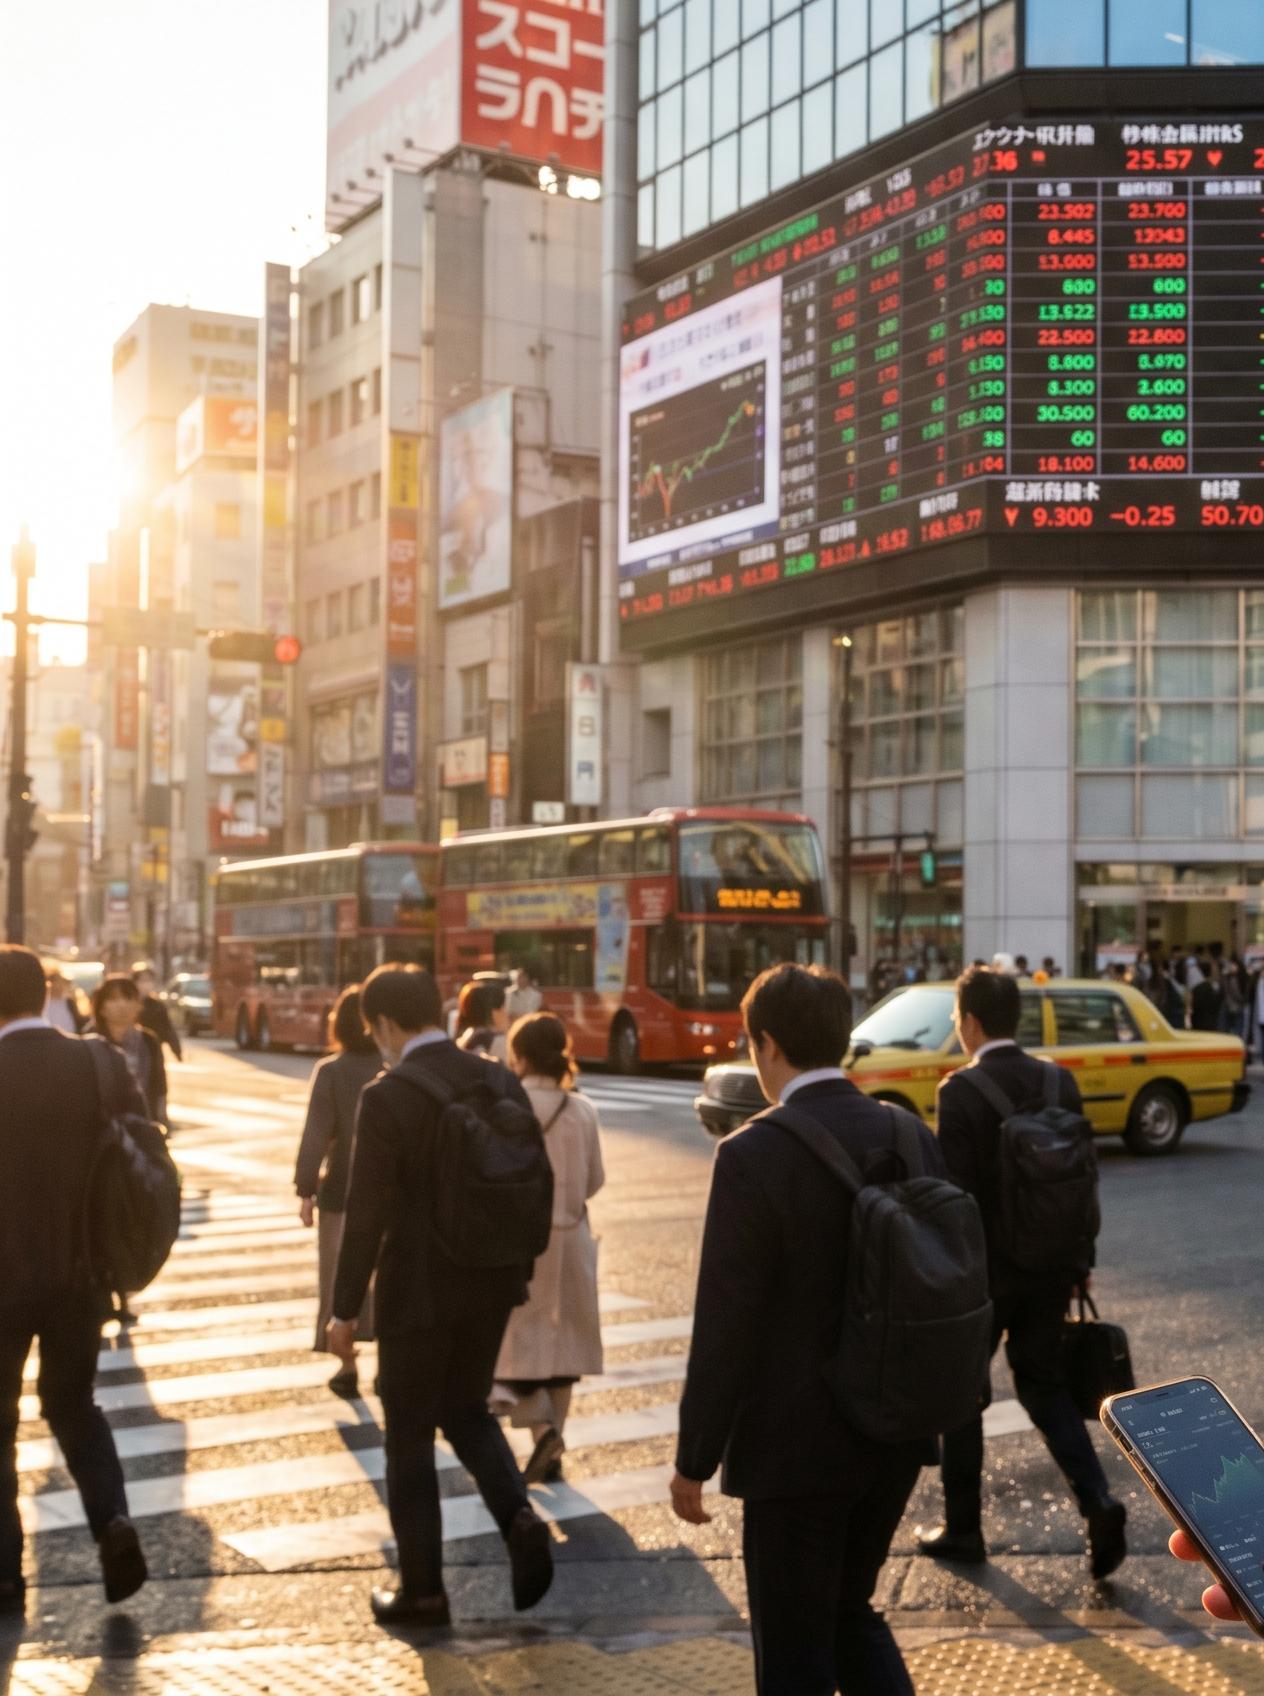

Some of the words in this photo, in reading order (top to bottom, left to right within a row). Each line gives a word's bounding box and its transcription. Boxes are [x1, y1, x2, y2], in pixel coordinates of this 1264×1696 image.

[1126, 148, 1193, 171] 25.57
[1038, 404, 1096, 422] 30.500
[1126, 403, 1186, 422] 60.200
[1071, 430, 1095, 447] 60
[1039, 455, 1094, 472] 18.100
[1128, 455, 1185, 472] 14.600
[1031, 506, 1093, 528] 9.300
[1200, 504, 1264, 526] 50.70
